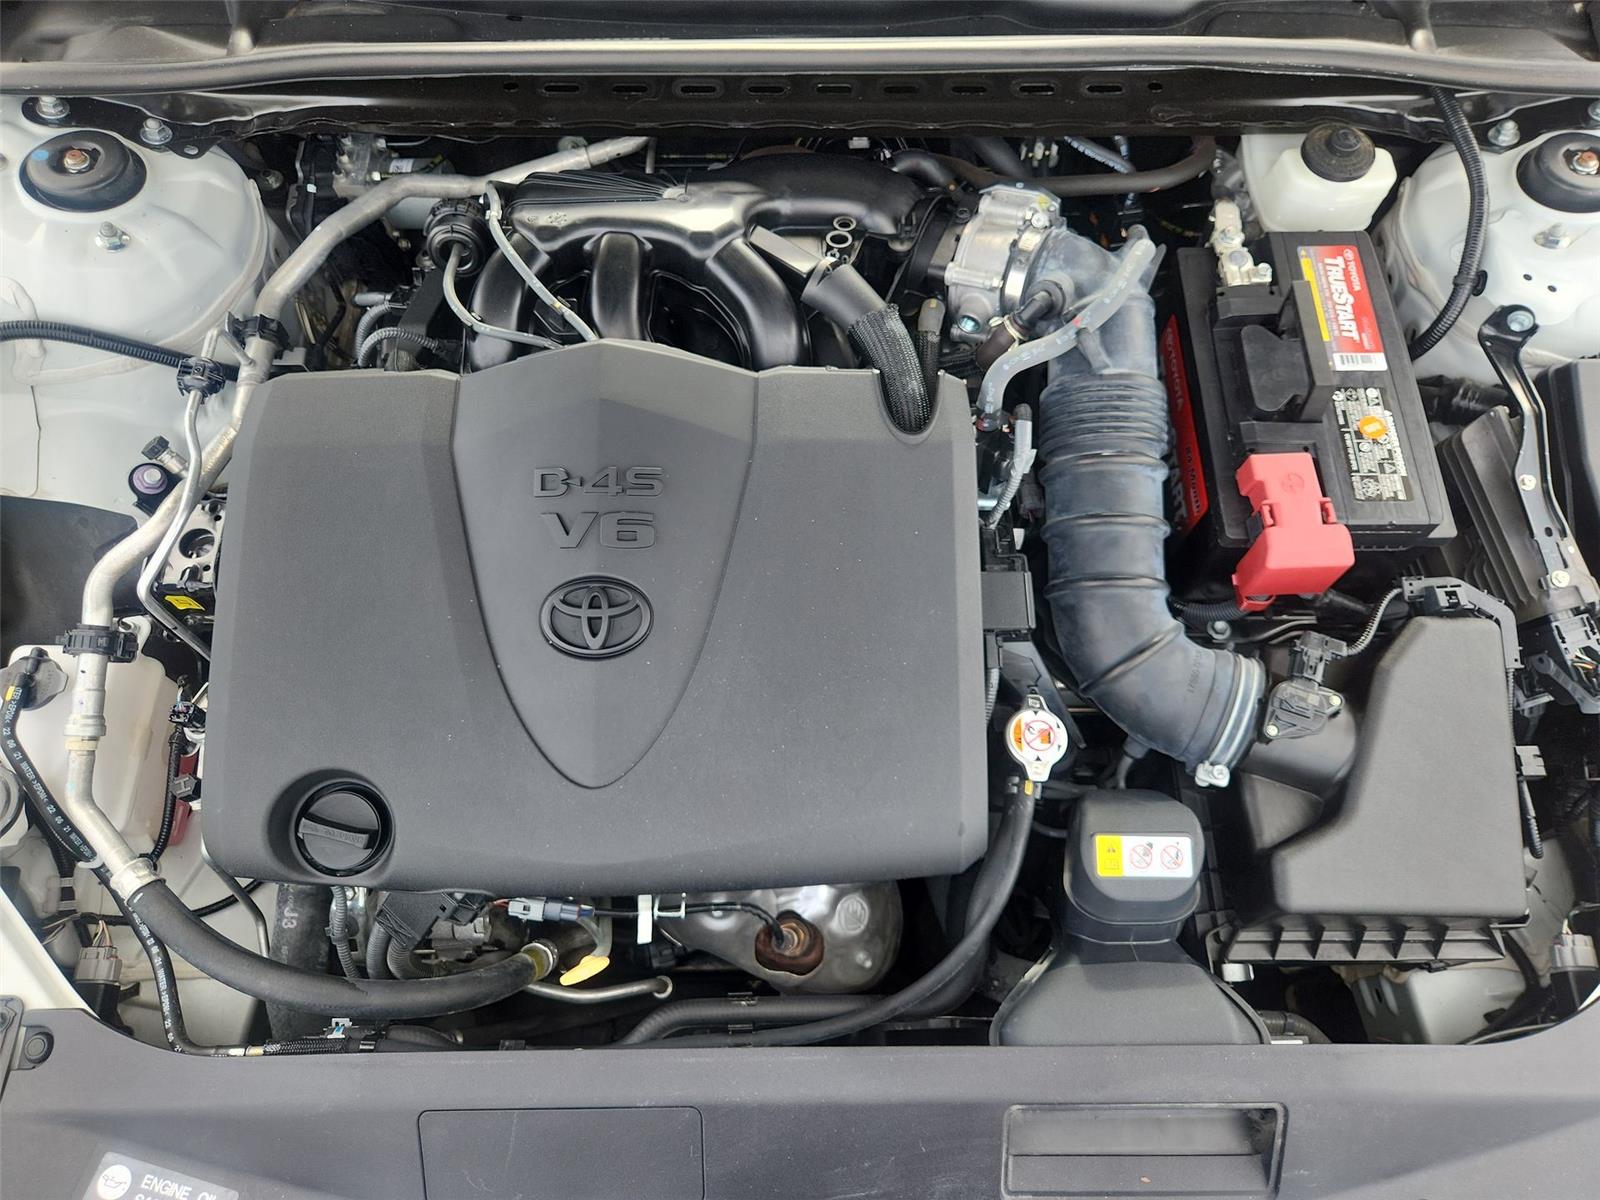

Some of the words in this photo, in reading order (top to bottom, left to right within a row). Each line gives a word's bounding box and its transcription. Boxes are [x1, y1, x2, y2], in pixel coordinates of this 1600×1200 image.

[1347, 261, 1361, 292] TOYOTA
[541, 511, 657, 549] V6
[141, 1173, 192, 1200] ENGINE
